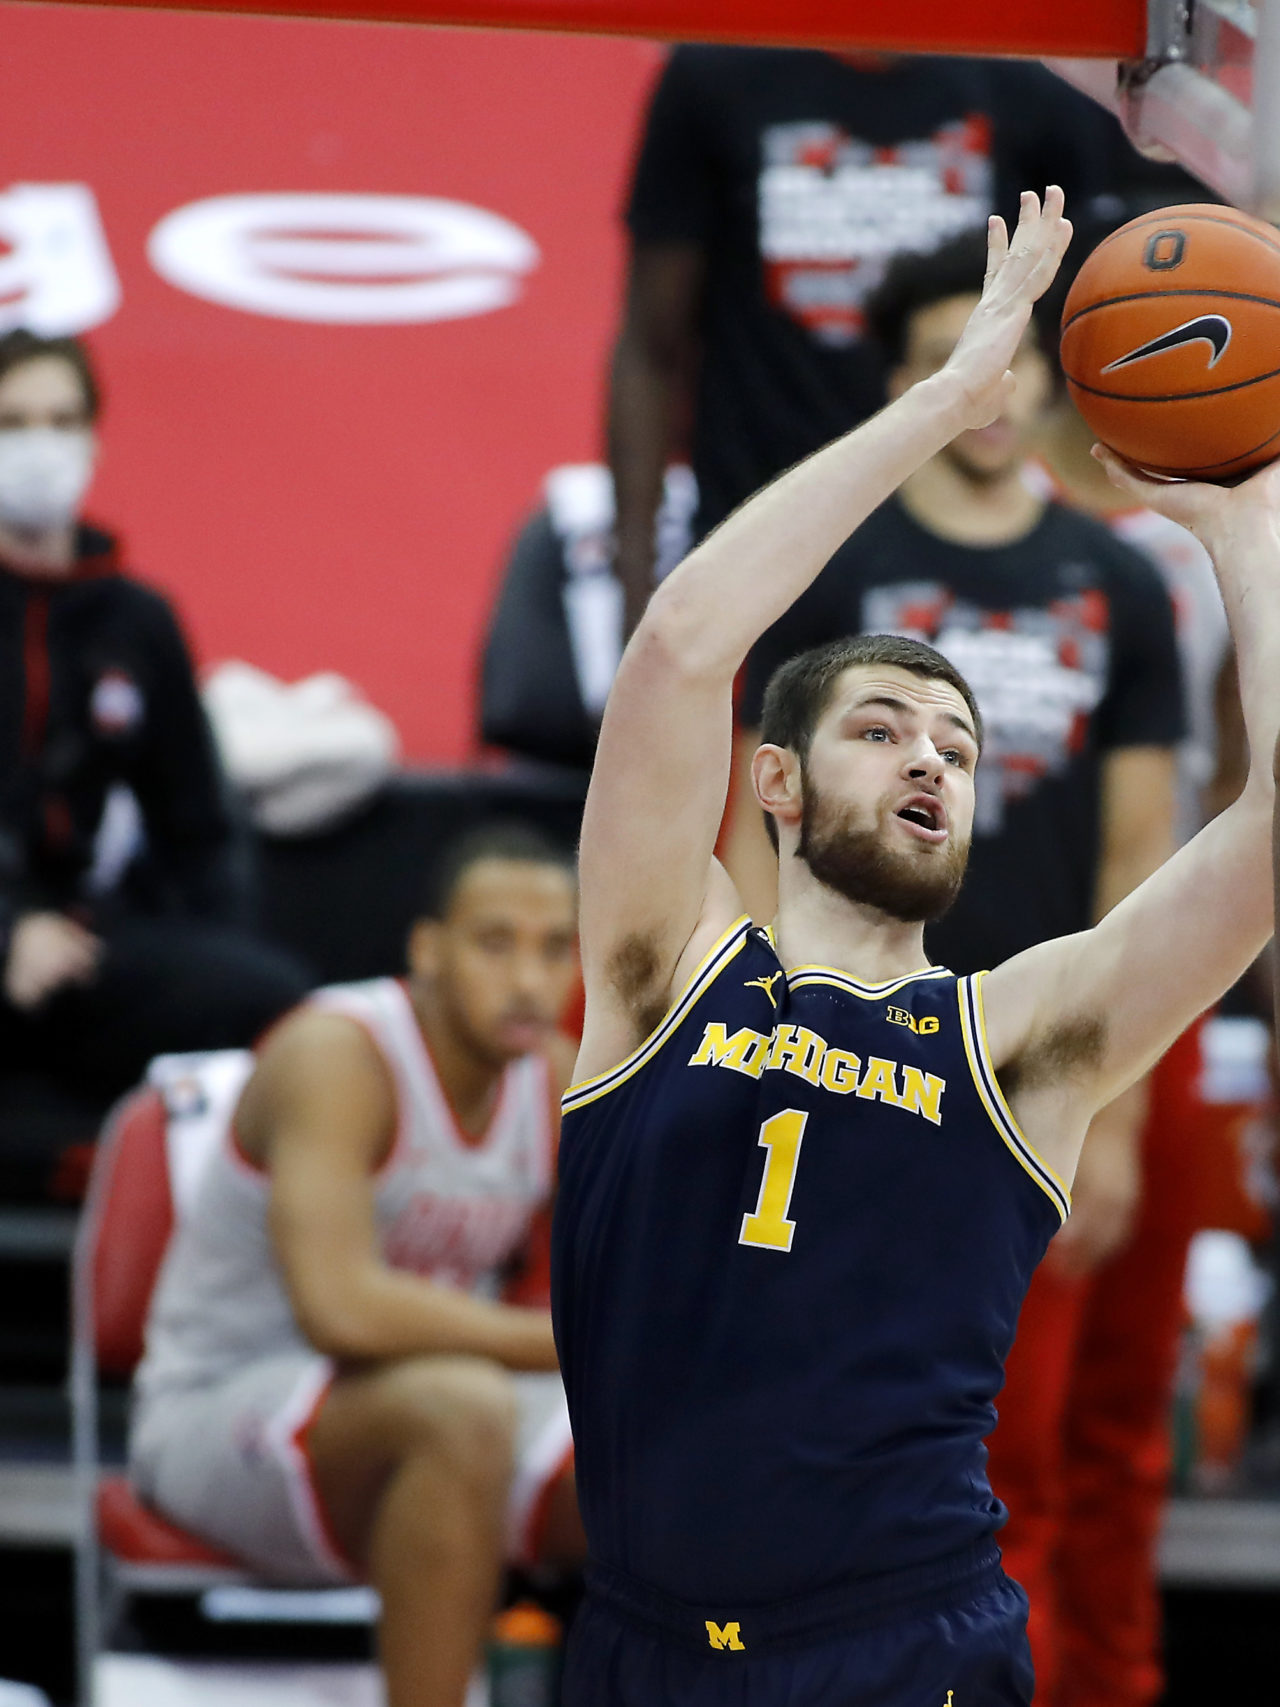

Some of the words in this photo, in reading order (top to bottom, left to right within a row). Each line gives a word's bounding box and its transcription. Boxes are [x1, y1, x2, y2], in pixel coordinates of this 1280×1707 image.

[687, 1022, 946, 1126] MIHIGAN
[738, 1108, 808, 1252] 1
[705, 1620, 746, 1651] M
